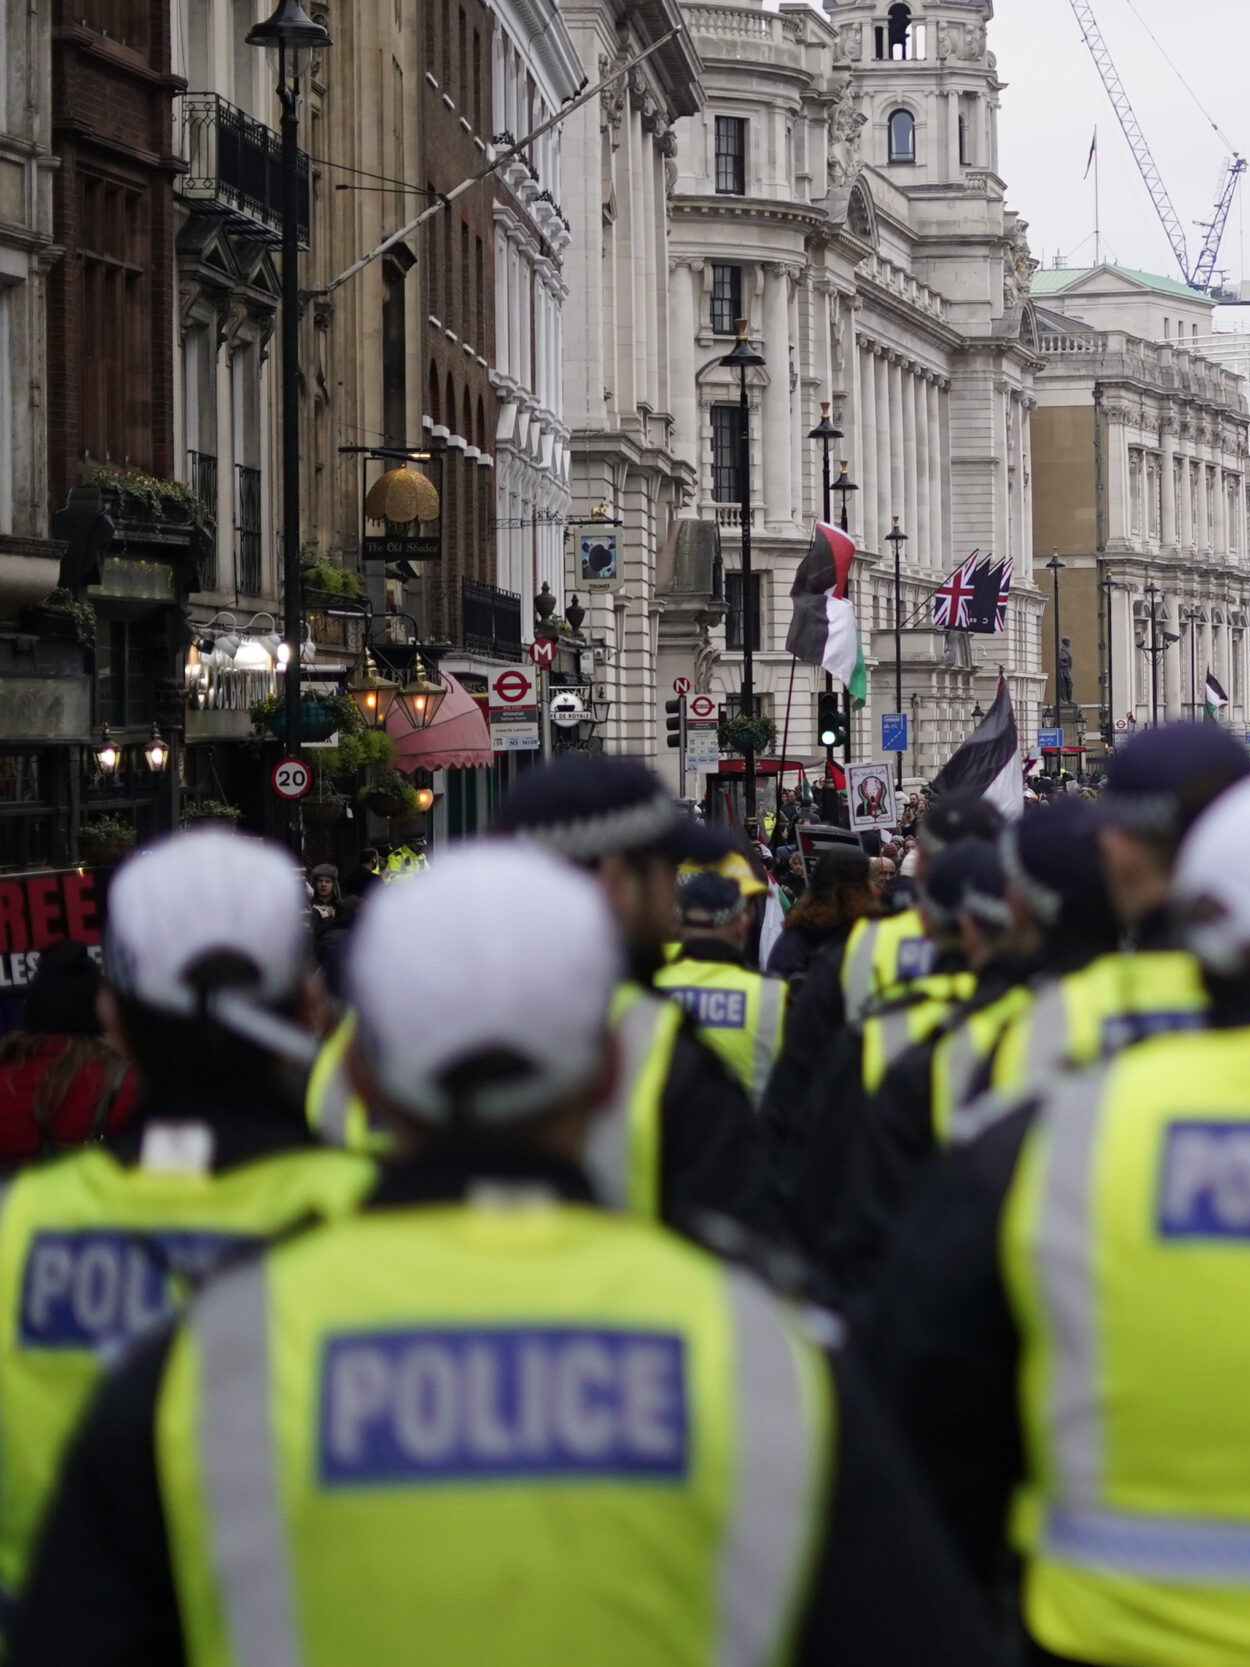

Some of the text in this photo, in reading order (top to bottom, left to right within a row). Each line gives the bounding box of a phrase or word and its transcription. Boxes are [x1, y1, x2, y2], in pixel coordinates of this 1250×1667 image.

[367, 542, 439, 552] The Old Shades
[533, 643, 552, 661] M
[675, 680, 688, 692] N
[278, 771, 306, 786] 20
[0, 873, 101, 955] REE
[671, 990, 744, 1022] LICE
[331, 1344, 680, 1464] POLICE
